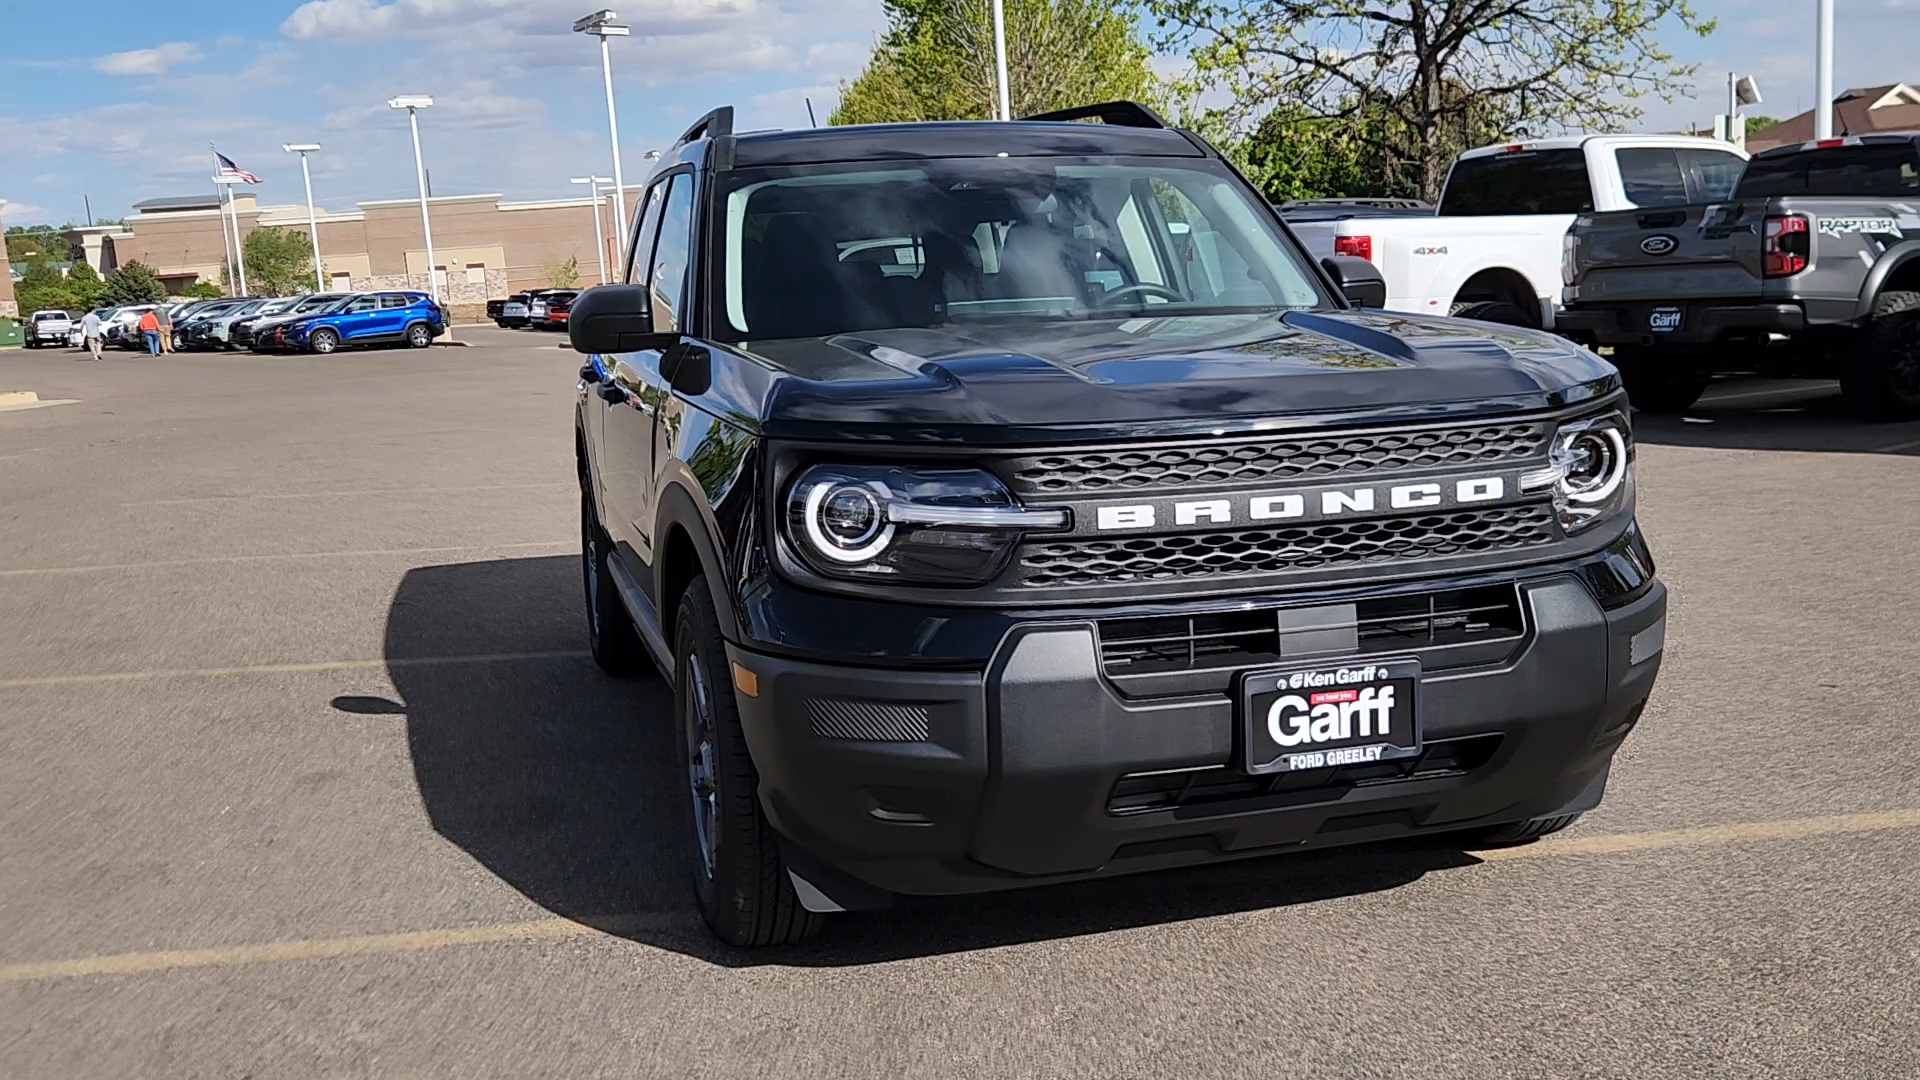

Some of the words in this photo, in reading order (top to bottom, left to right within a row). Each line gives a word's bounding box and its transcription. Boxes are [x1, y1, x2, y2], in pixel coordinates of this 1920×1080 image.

[1817, 217, 1904, 239] RAPTOR
[1650, 313, 1681, 327] Garff
[1097, 476, 1504, 530] BRONCO
[1303, 672, 1335, 688] Ken
[1336, 665, 1376, 685] Garff
[1267, 685, 1395, 747] Garff
[1289, 754, 1325, 770] FORD
[1326, 746, 1383, 767] GREELEY
